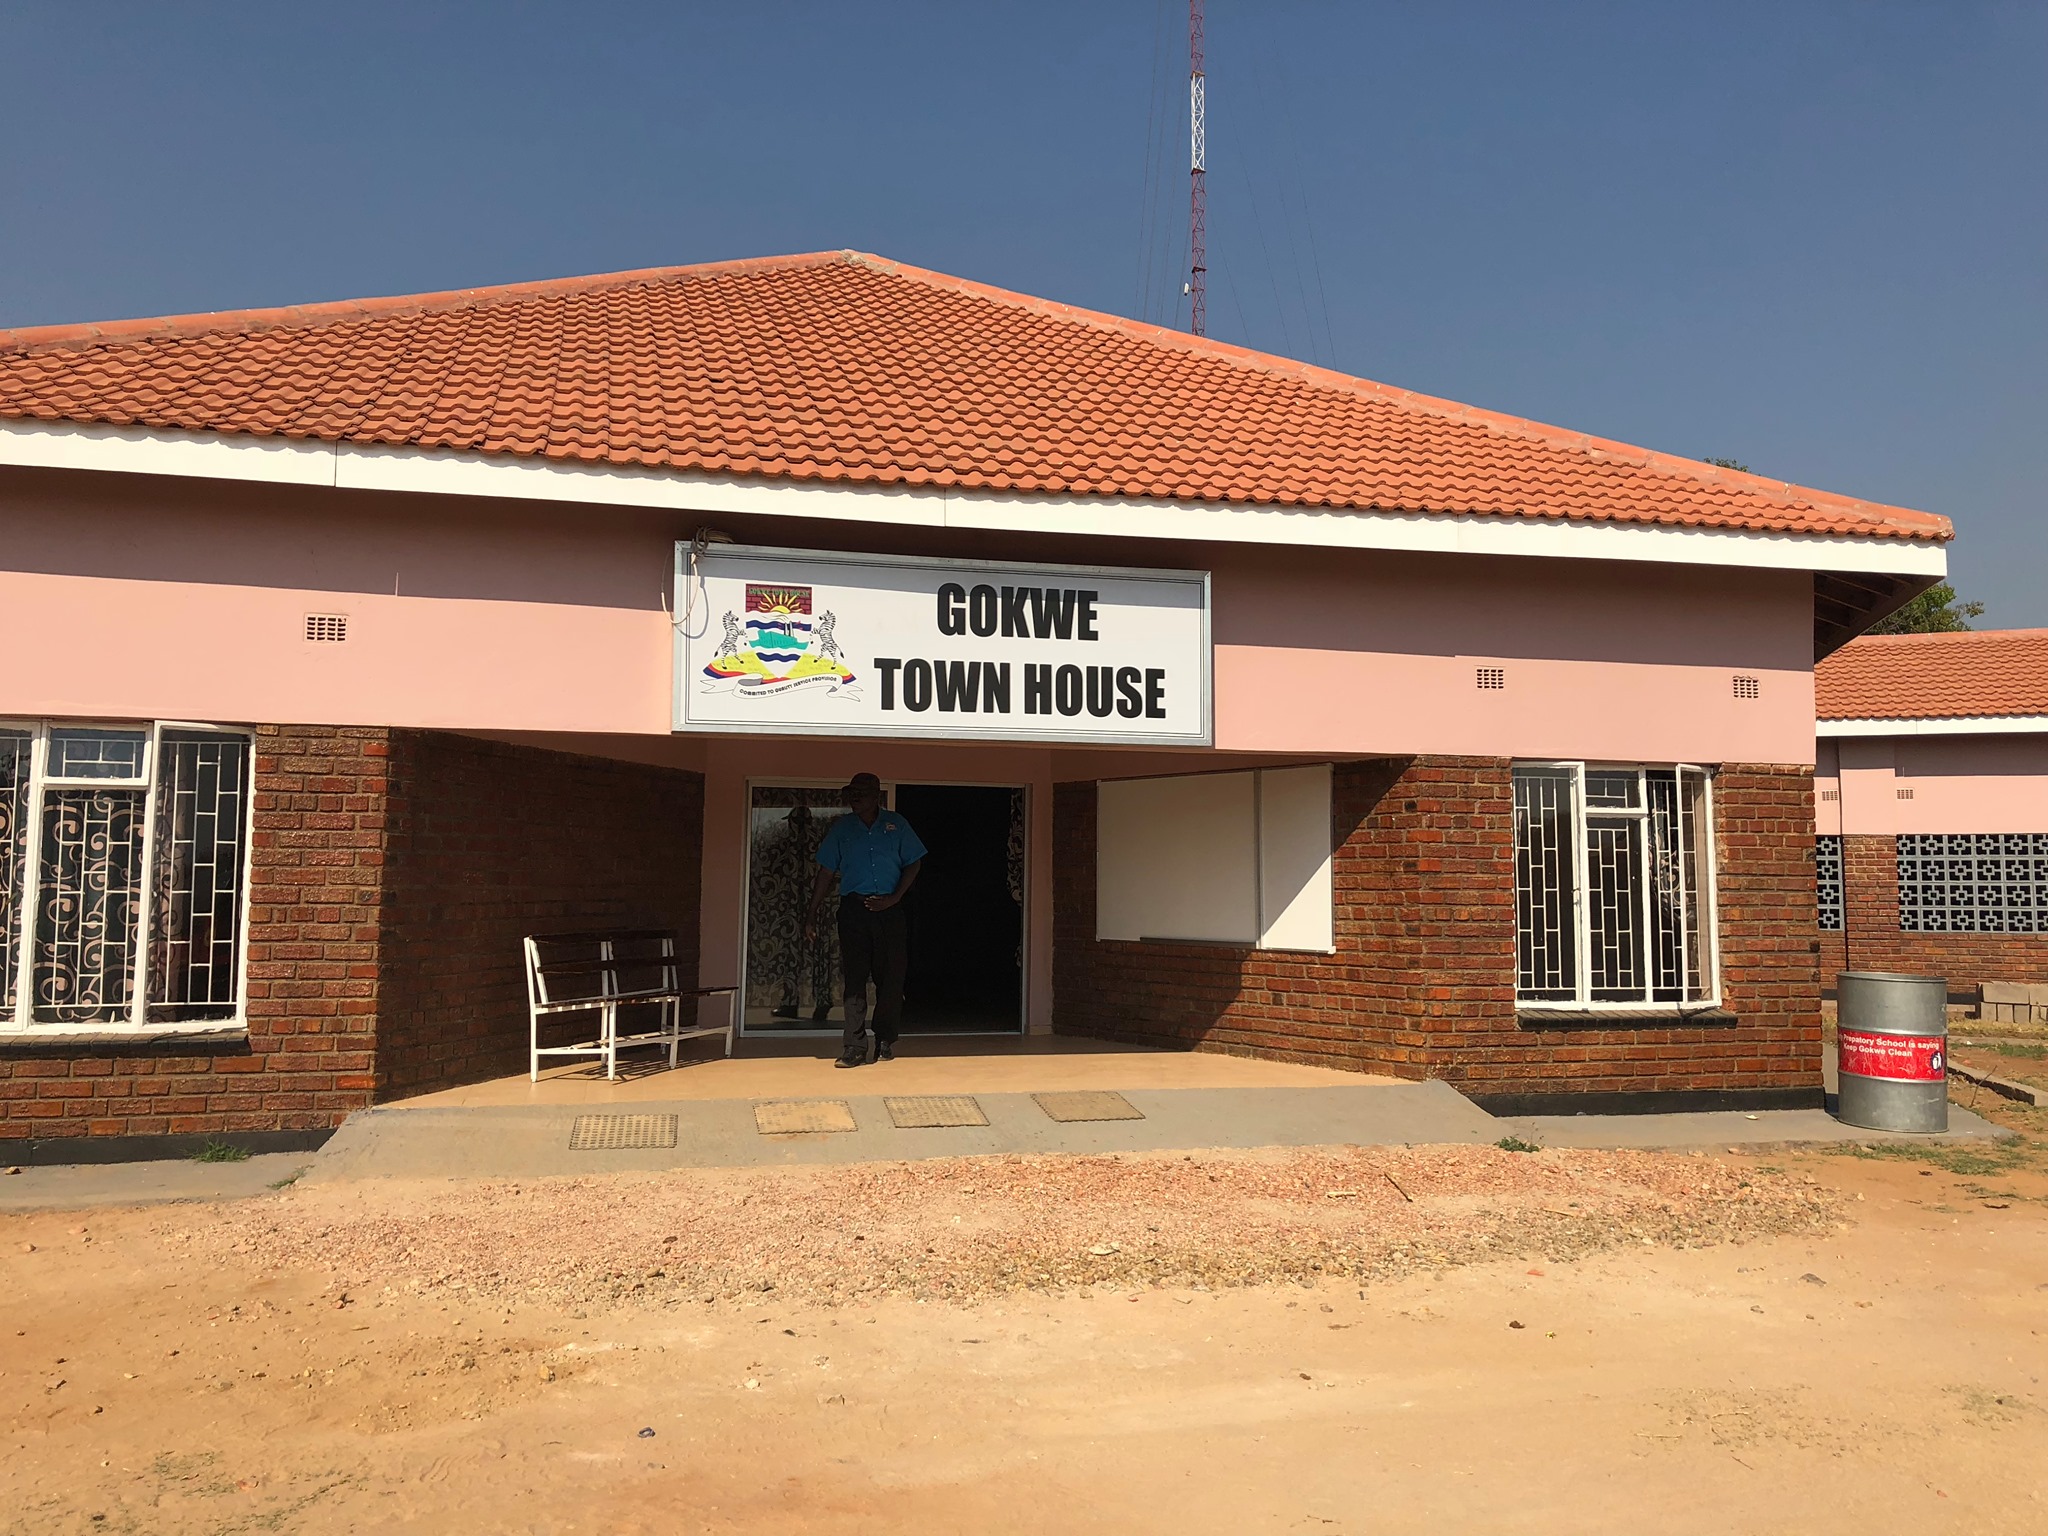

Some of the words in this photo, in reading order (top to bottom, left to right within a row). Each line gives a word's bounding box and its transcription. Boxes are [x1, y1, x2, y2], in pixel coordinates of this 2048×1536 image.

[937, 583, 1099, 641] GOKWE
[874, 658, 1010, 714] TOWN
[1024, 663, 1166, 719] HOUSE
[1844, 1043, 1857, 1052] Keep
[1858, 1045, 1886, 1054] Gokwe
[1888, 1048, 1912, 1057] Clean
[1876, 1038, 1906, 1047] School
